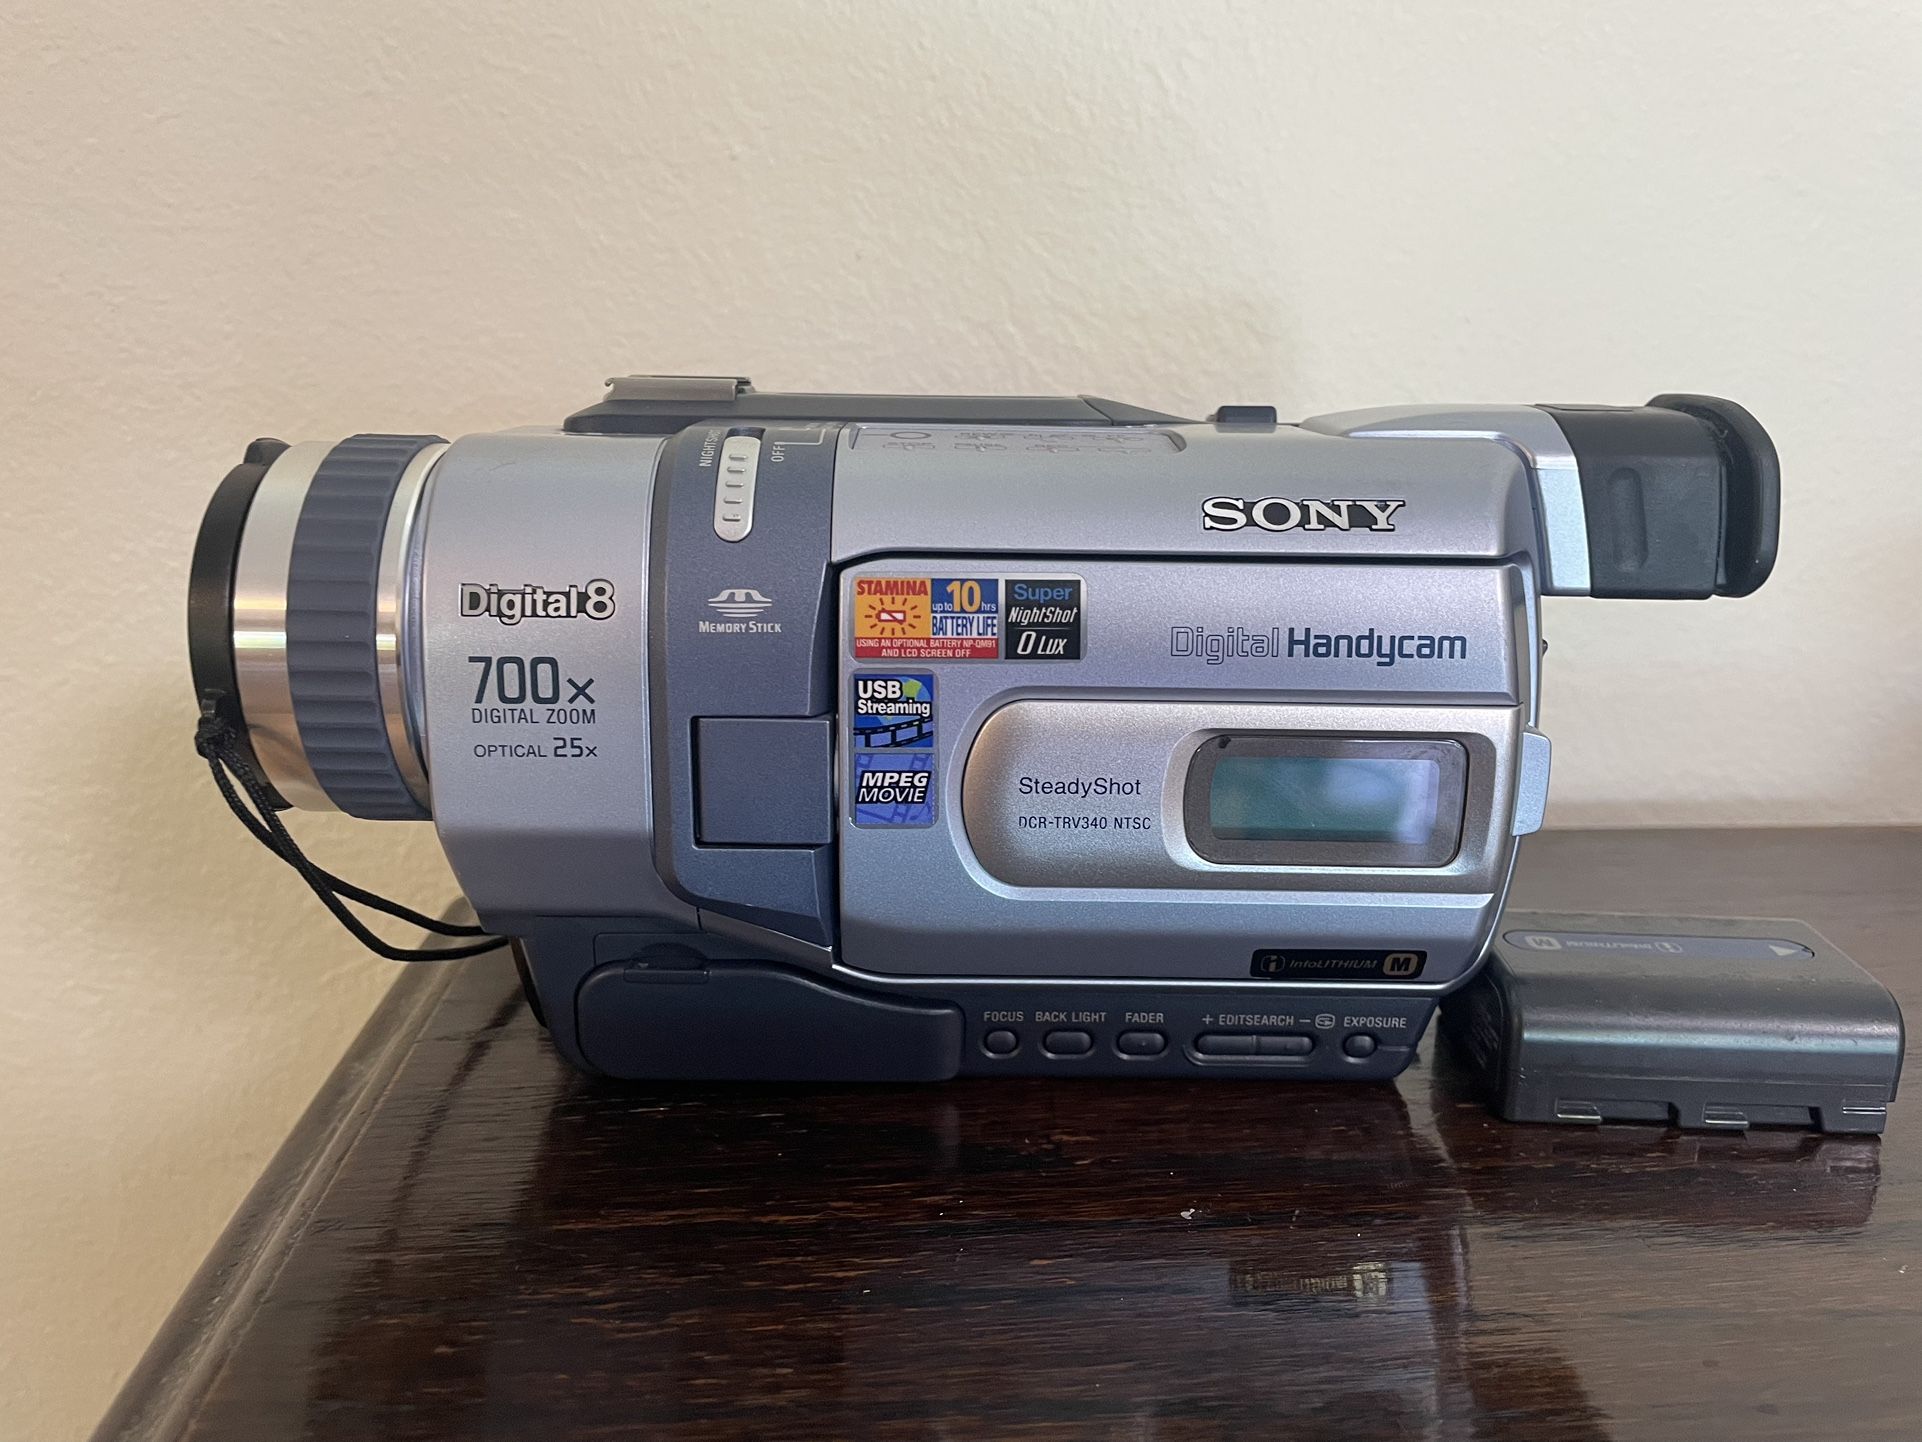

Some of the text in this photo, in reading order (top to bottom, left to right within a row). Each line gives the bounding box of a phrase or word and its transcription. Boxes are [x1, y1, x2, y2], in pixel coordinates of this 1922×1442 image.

[770, 443, 786, 462] OFF
[1202, 496, 1406, 532] SONY
[857, 580, 929, 596] STAMINA
[1014, 583, 1073, 603] Super
[946, 580, 981, 613] 10
[981, 602, 997, 612] hrs
[1008, 606, 1078, 626] NightShot
[932, 616, 997, 637] BATTERY LIFE
[856, 639, 879, 648] USING
[880, 639, 891, 648] AN
[893, 639, 928, 648] OPTIONAL
[930, 639, 961, 648] BATTERY
[1171, 626, 1467, 667] Digital Handycam
[881, 648, 971, 657] AND LCD SCREEN OFF
[857, 680, 901, 699] USB
[472, 708, 597, 724] DIGITAL ZOOM
[857, 700, 931, 716] Streaming
[473, 737, 598, 758] OPTICAL 25x
[861, 772, 929, 787] MPEG
[1018, 776, 1142, 799] SteadyShot
[858, 787, 926, 802] MOVIE
[1018, 816, 1151, 830] DCR-TRV340 NTSC
[983, 1011, 1024, 1023] FOCUS
[1035, 1011, 1106, 1023] BACK LIGHT
[1125, 1012, 1164, 1024] FADER
[1218, 1013, 1294, 1027] EDITSEARCH
[1343, 1016, 1407, 1029] EXPOSURE
